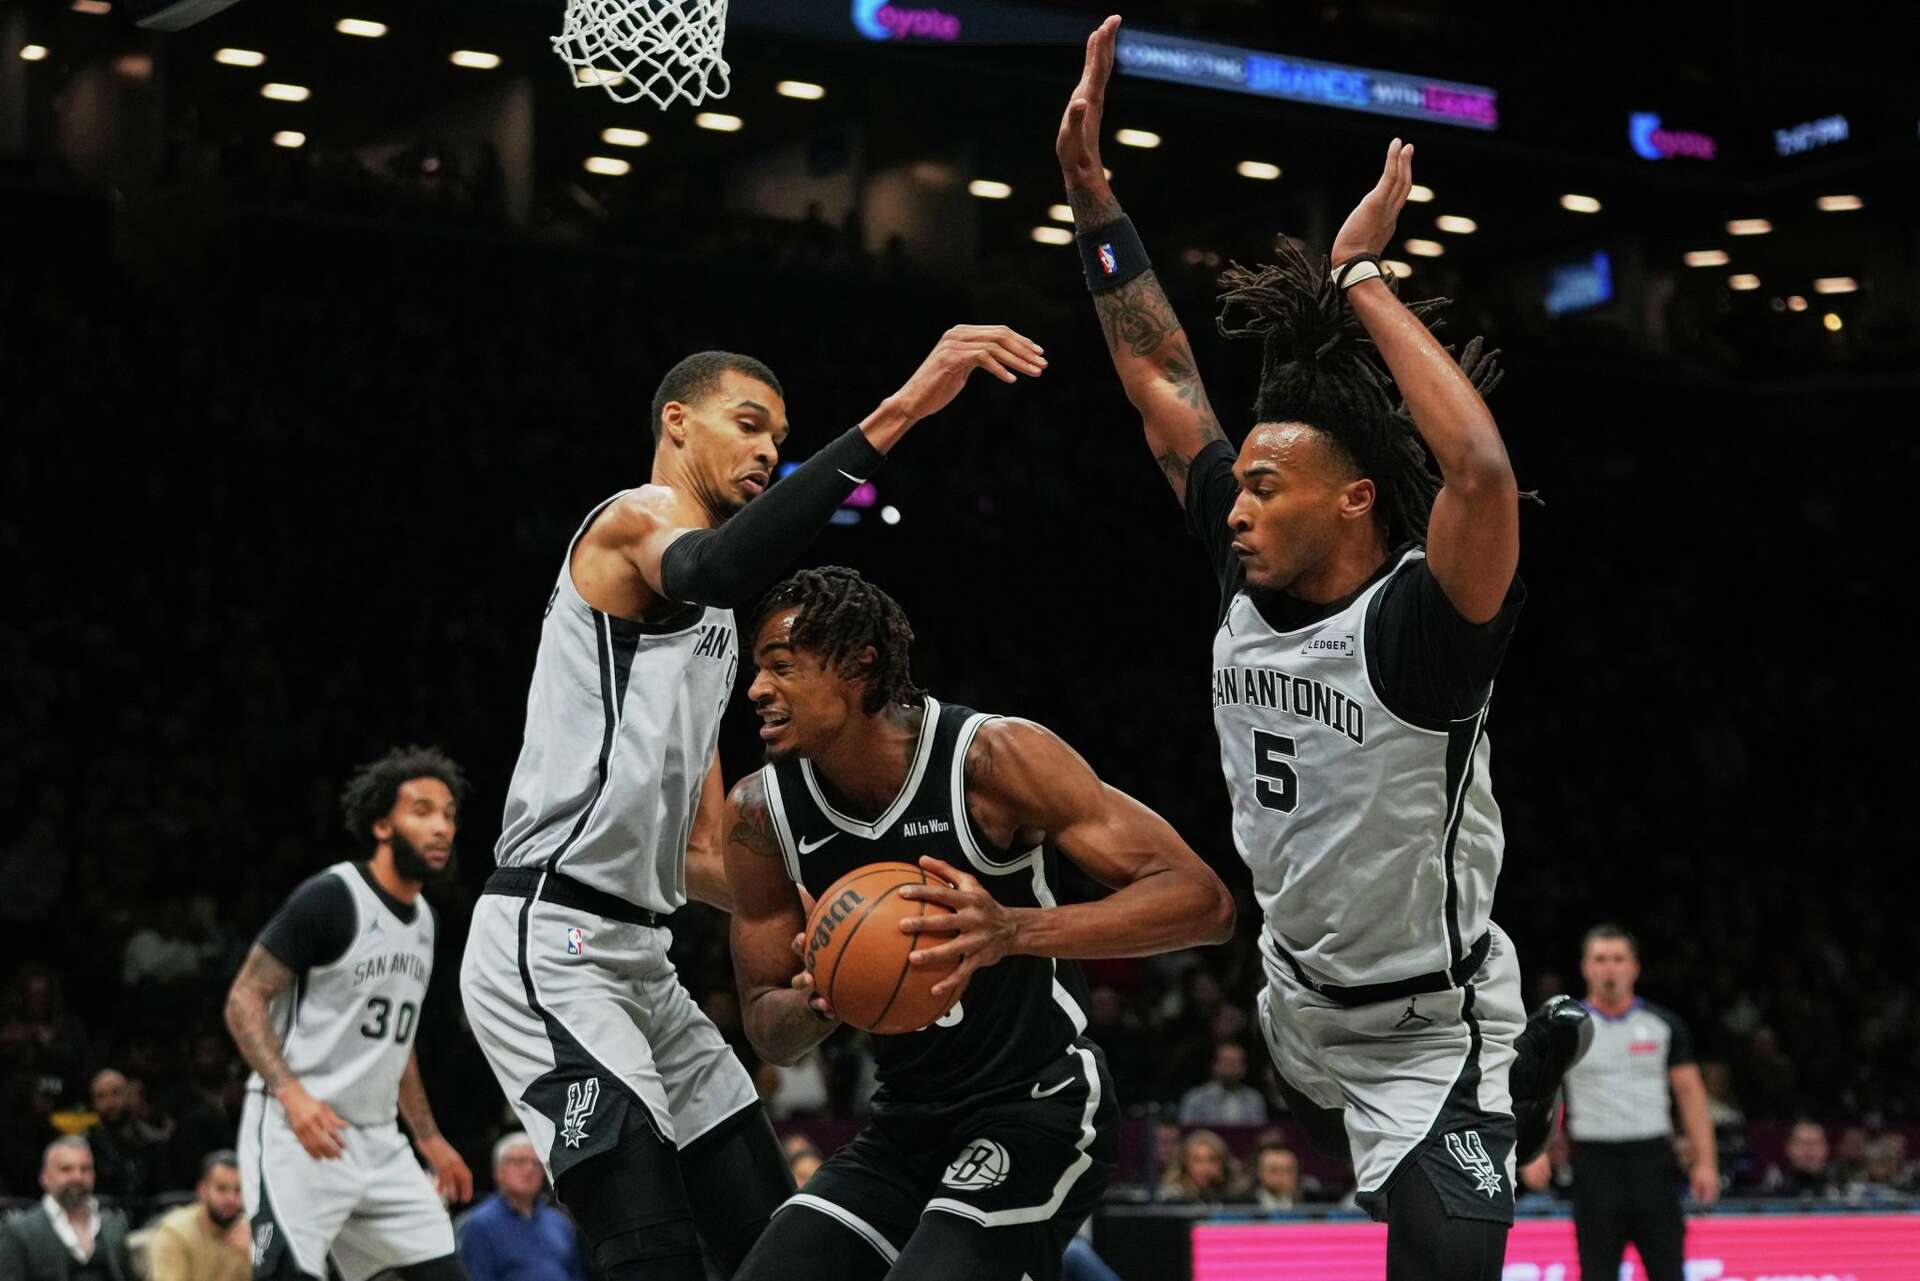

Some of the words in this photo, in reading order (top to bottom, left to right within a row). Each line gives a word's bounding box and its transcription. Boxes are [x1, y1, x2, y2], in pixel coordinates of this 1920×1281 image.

[1308, 639, 1347, 651] LEDGER
[1213, 667, 1239, 708] AN
[1244, 667, 1365, 746] ANTONIO
[1252, 728, 1299, 815] 5
[904, 823, 917, 837] All
[918, 821, 929, 835] In
[929, 819, 949, 833] Won
[354, 956, 387, 986] SAN
[361, 998, 416, 1043] 30
